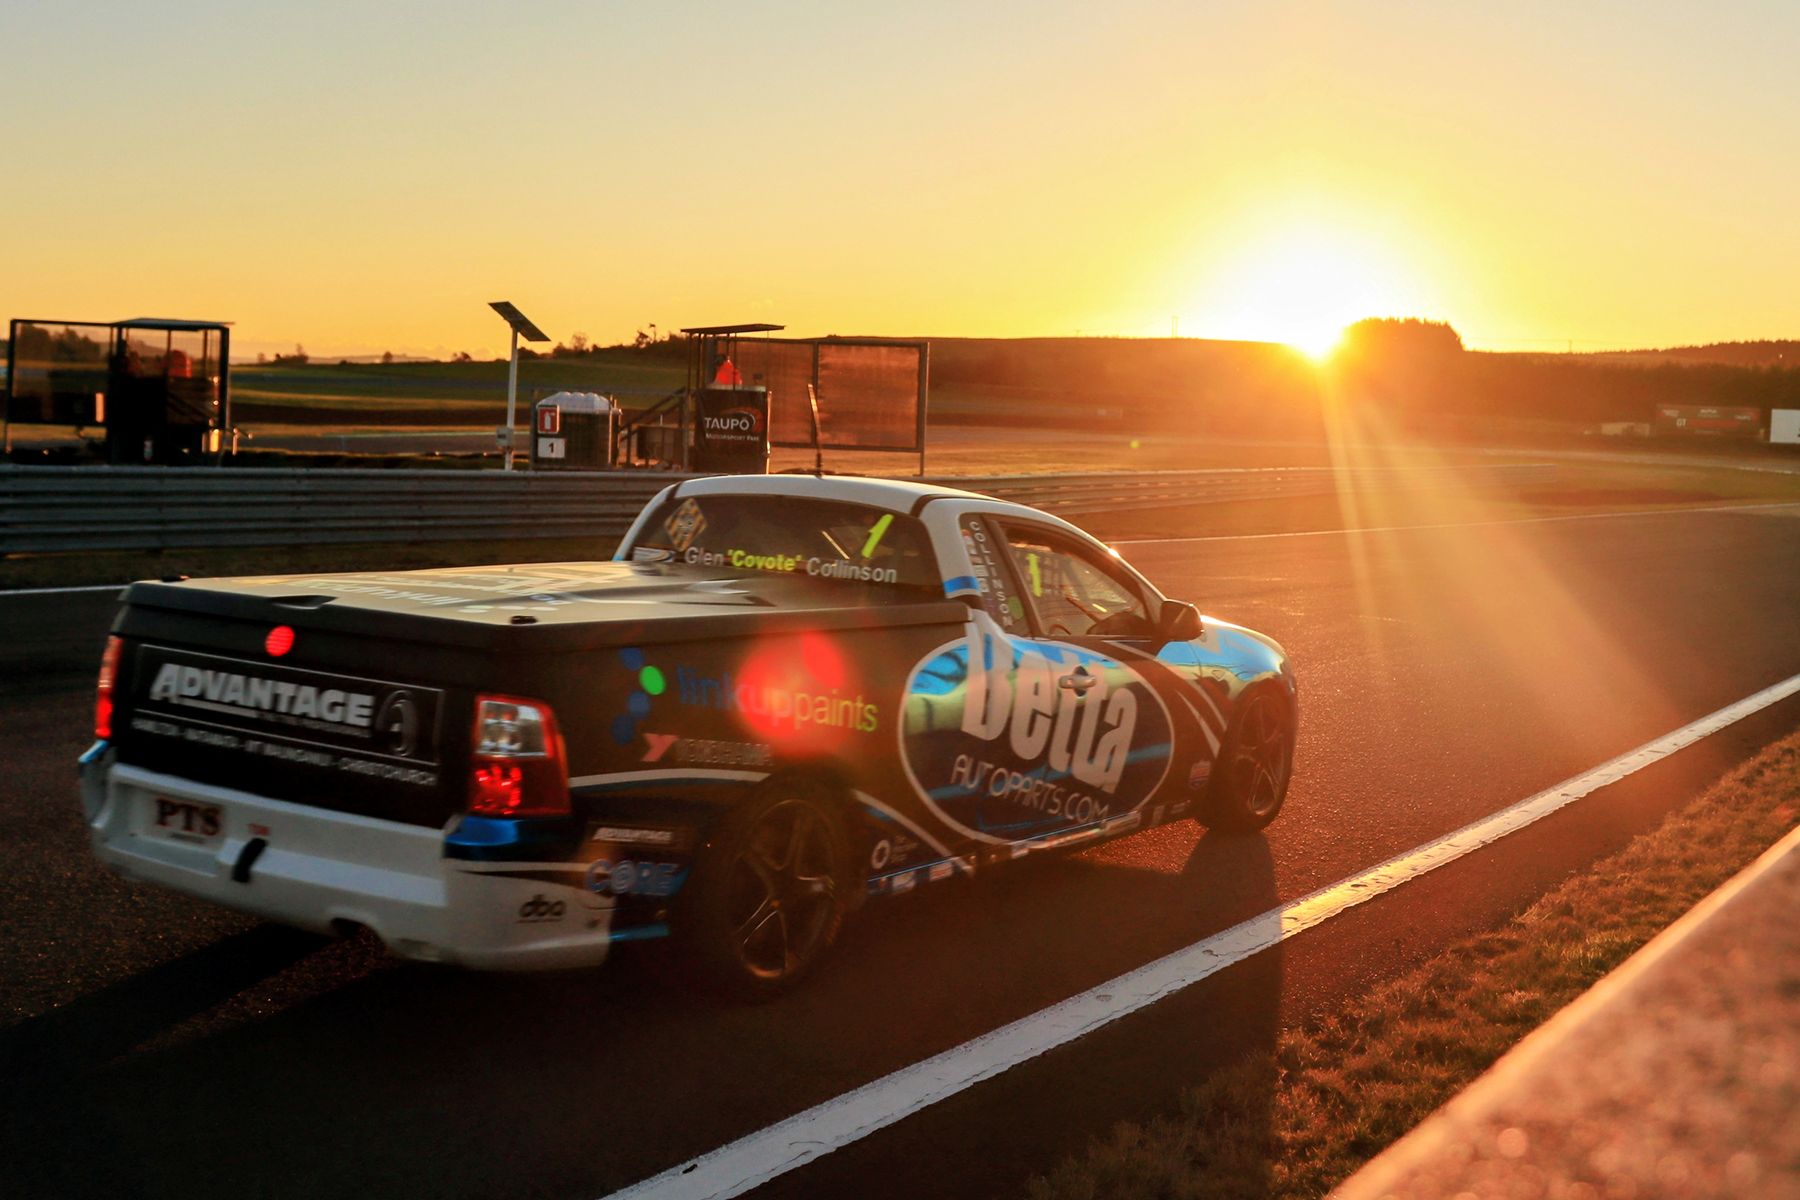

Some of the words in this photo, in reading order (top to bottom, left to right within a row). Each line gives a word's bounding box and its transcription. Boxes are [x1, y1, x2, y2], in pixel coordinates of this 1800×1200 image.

[548, 441, 555, 454] 1
[861, 513, 895, 560] 1
[684, 546, 724, 565] Glen
[806, 557, 898, 584] Collinson
[969, 520, 1014, 629] COLLINSON
[1026, 553, 1042, 598] 1
[149, 662, 375, 728] ADVANTAGE
[155, 797, 223, 837] PTS
